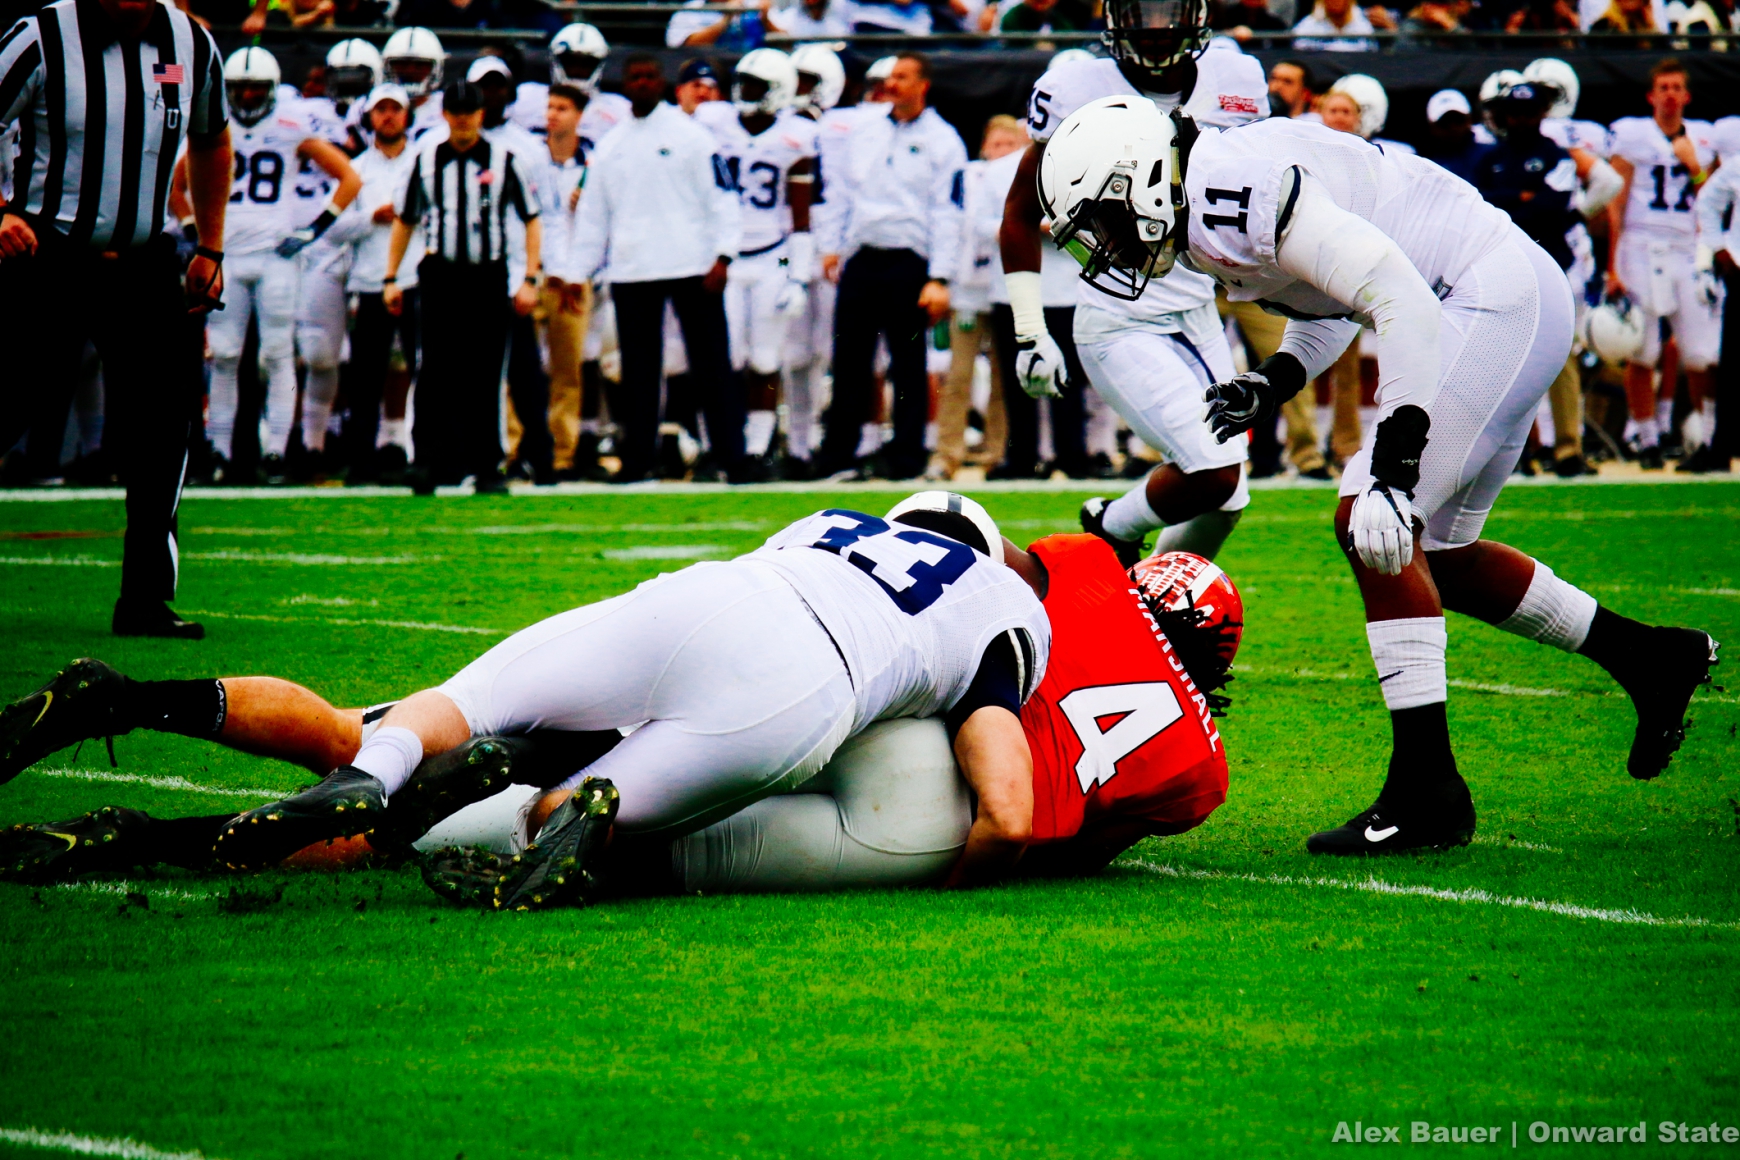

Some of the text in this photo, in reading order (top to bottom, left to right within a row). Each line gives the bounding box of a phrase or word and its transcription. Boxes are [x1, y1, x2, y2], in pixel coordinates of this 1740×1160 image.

[167, 108, 180, 129] U
[1202, 186, 1253, 235] 11
[1648, 164, 1693, 213] 17
[812, 508, 977, 617] 33
[1056, 680, 1186, 797] 4
